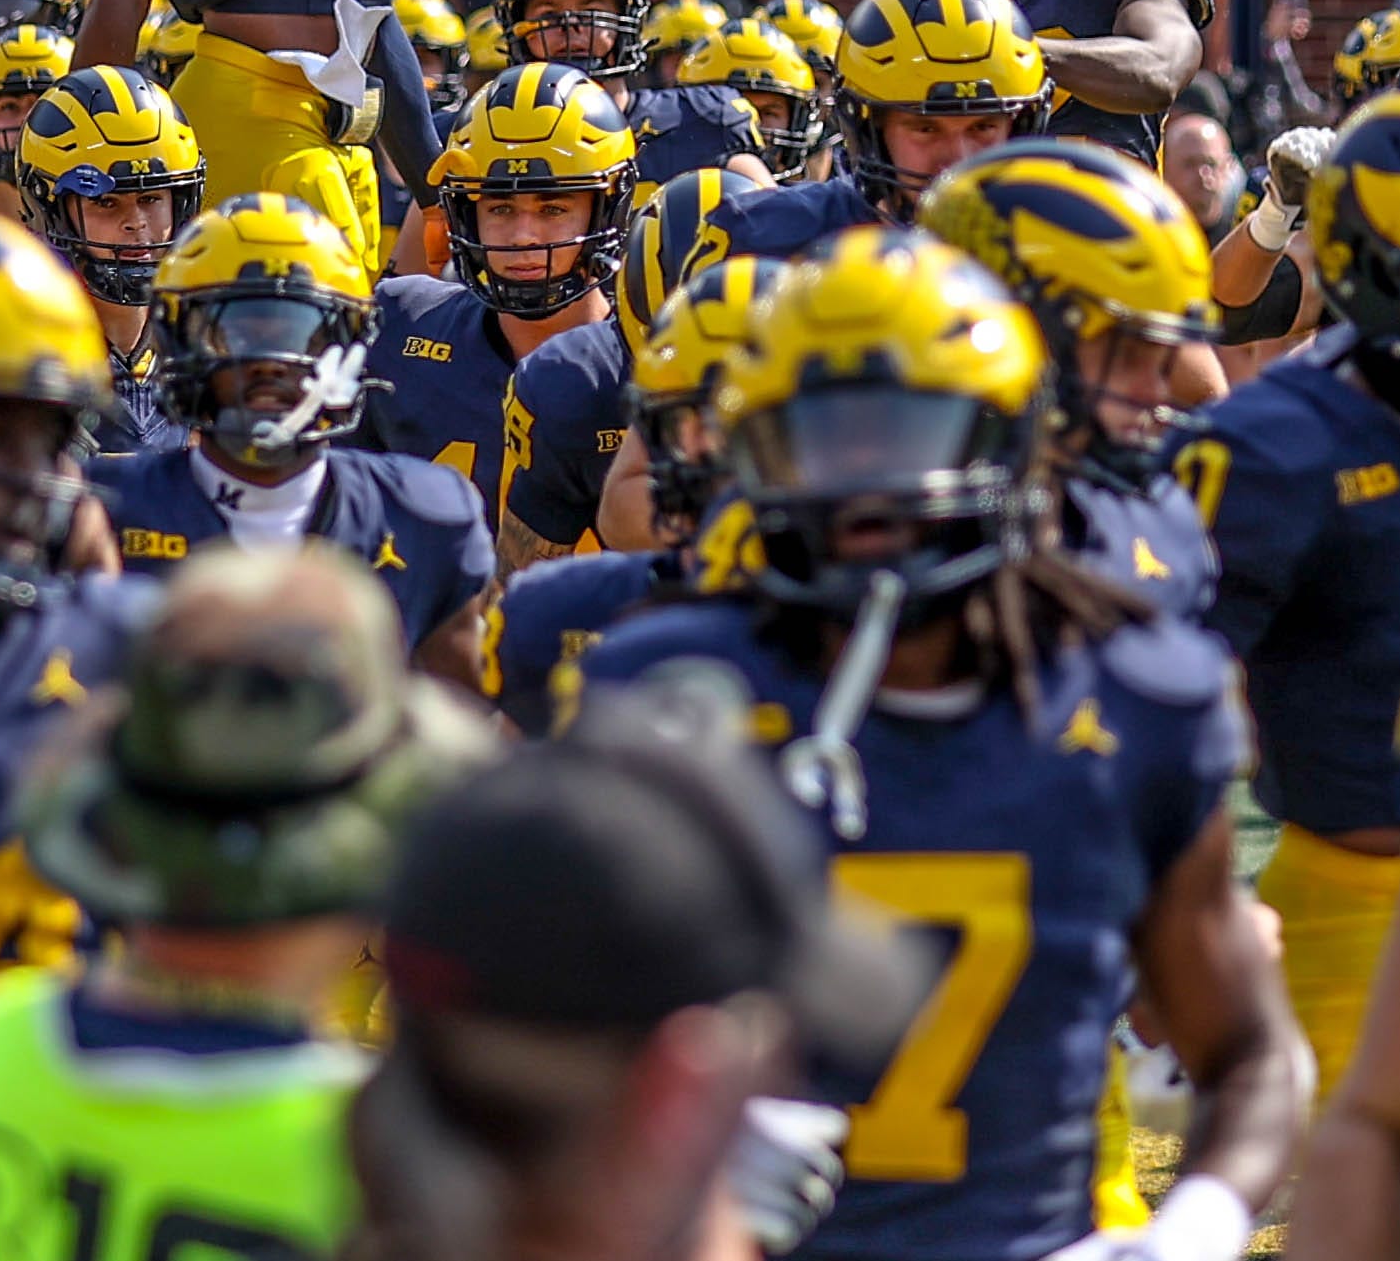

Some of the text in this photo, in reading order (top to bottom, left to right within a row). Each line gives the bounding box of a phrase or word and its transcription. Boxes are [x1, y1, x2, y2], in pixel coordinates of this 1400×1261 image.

[955, 82, 976, 97] M
[131, 160, 150, 173] M
[509, 160, 528, 173] M
